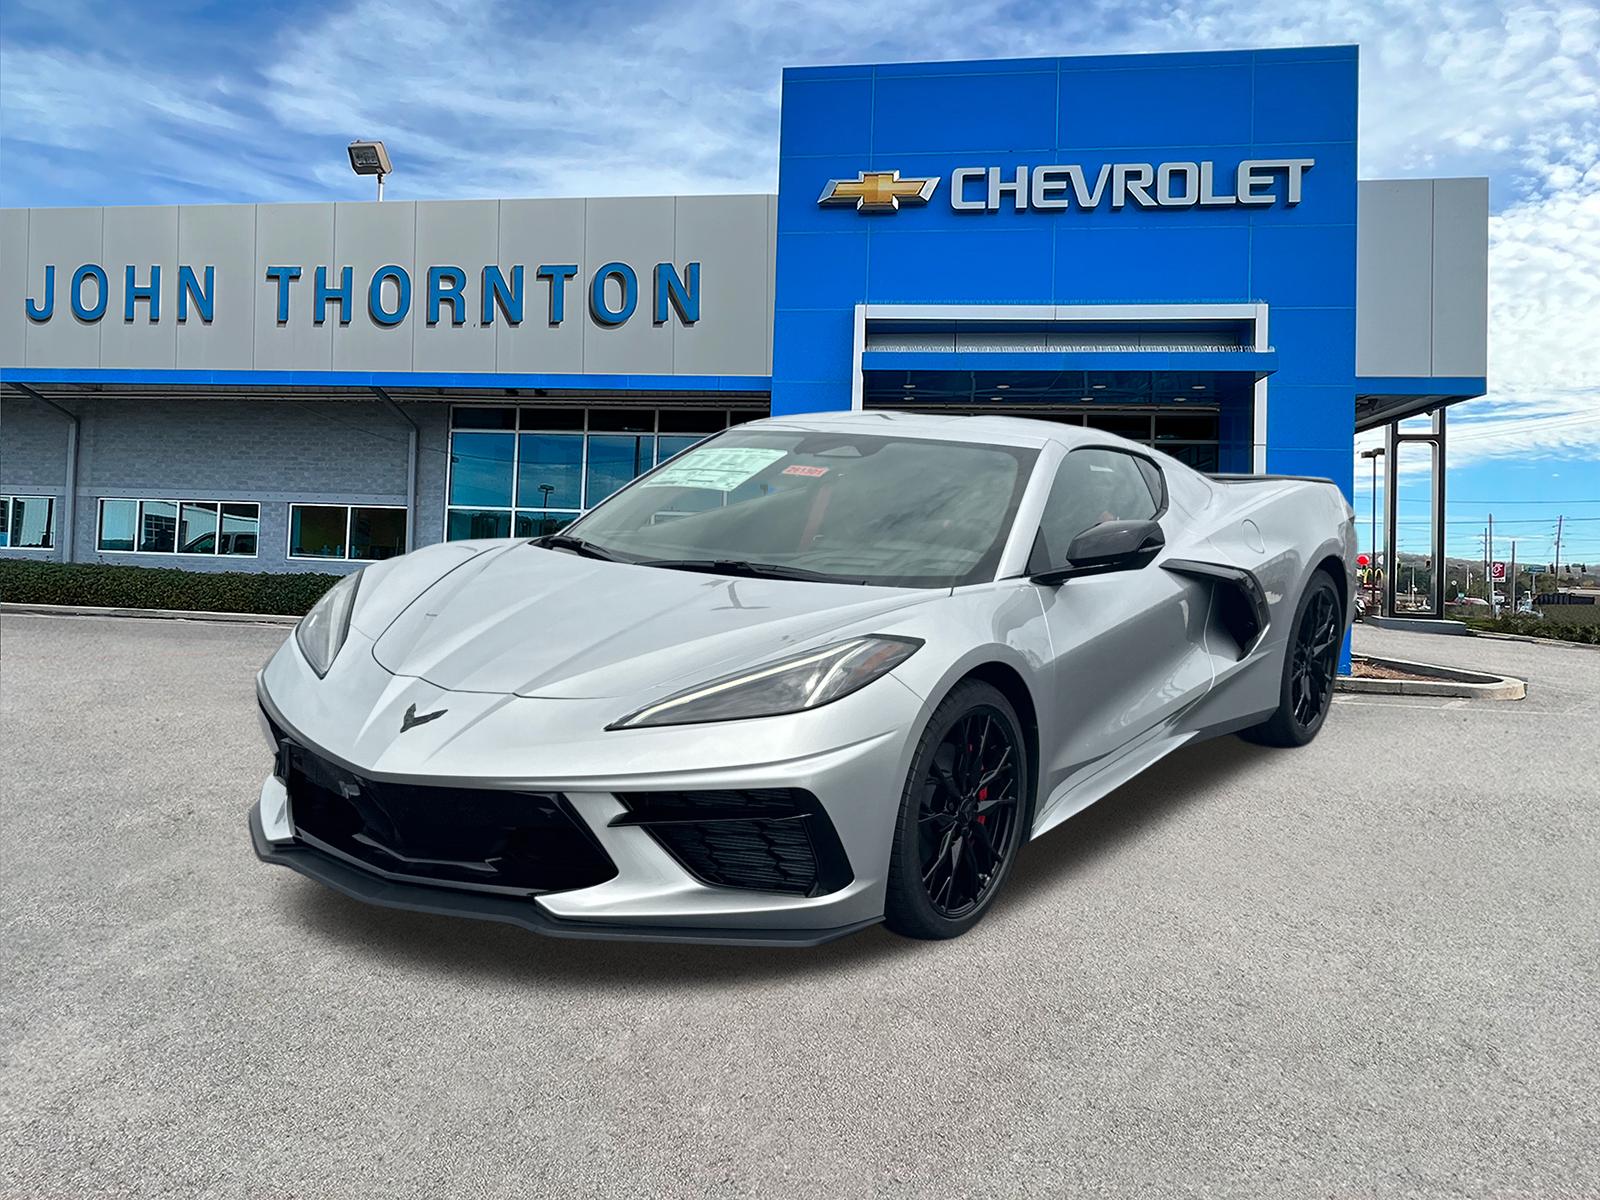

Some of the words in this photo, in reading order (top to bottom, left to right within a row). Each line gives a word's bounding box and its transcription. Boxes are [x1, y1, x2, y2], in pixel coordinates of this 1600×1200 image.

[951, 158, 1315, 210] CHEVROLET
[25, 264, 215, 323] JOHN
[266, 262, 701, 326] THORNTON
